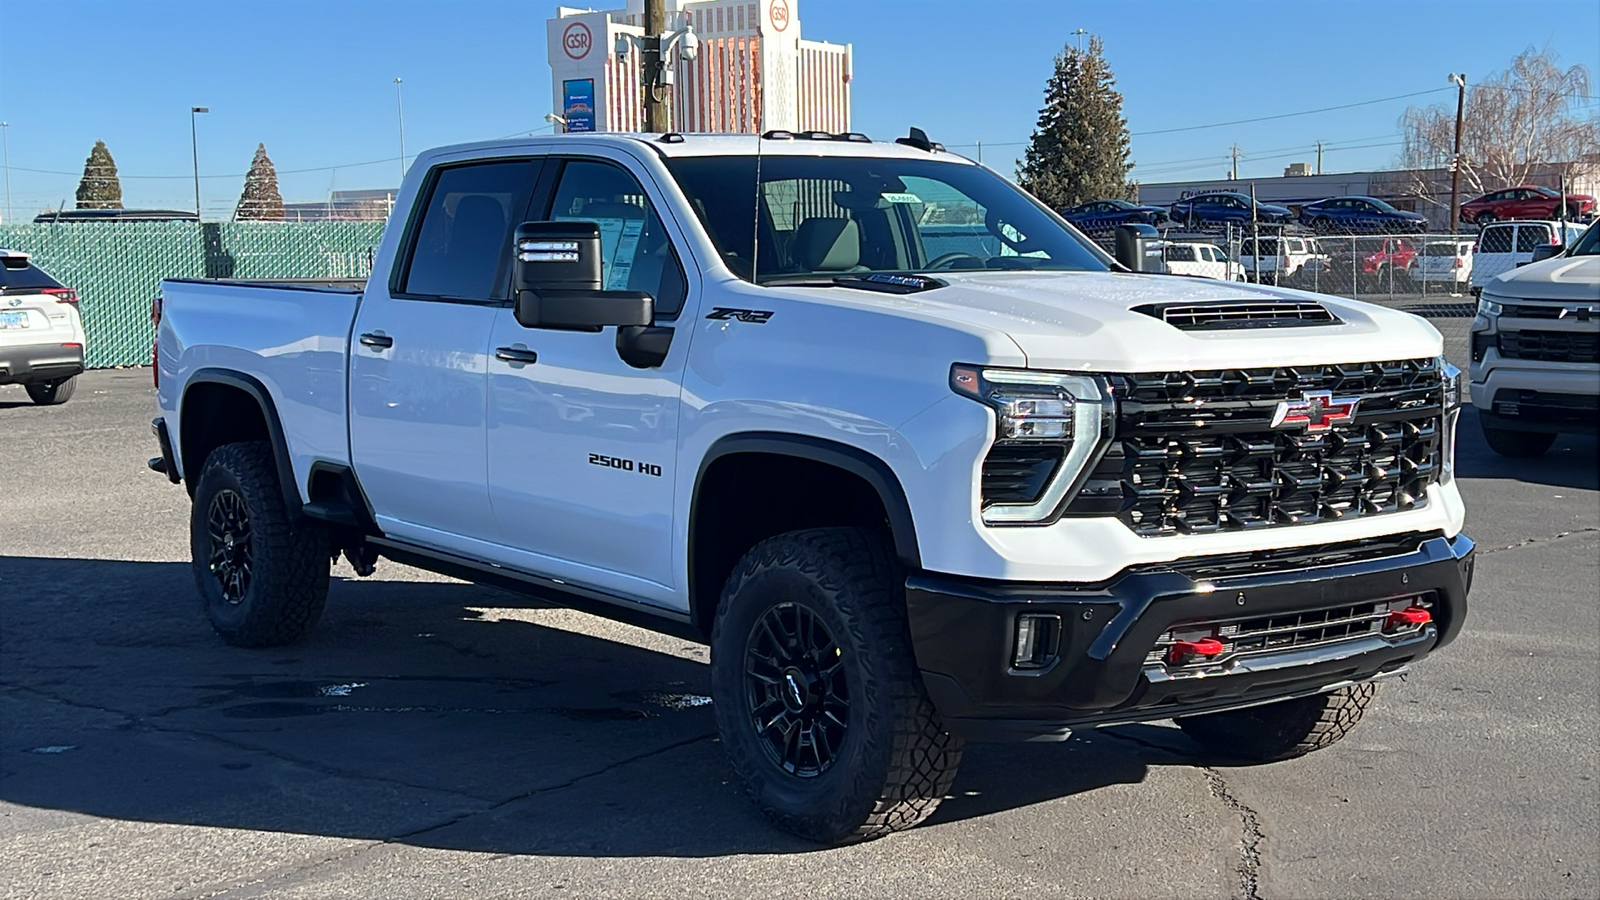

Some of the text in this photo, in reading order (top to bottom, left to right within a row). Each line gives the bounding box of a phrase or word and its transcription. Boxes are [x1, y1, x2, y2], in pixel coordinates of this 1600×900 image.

[772, 6, 787, 22] GSR
[566, 33, 588, 49] GSR
[705, 306, 775, 324] ZR2
[1400, 399, 1426, 409] ZR2
[588, 452, 662, 477] 2500 HD
